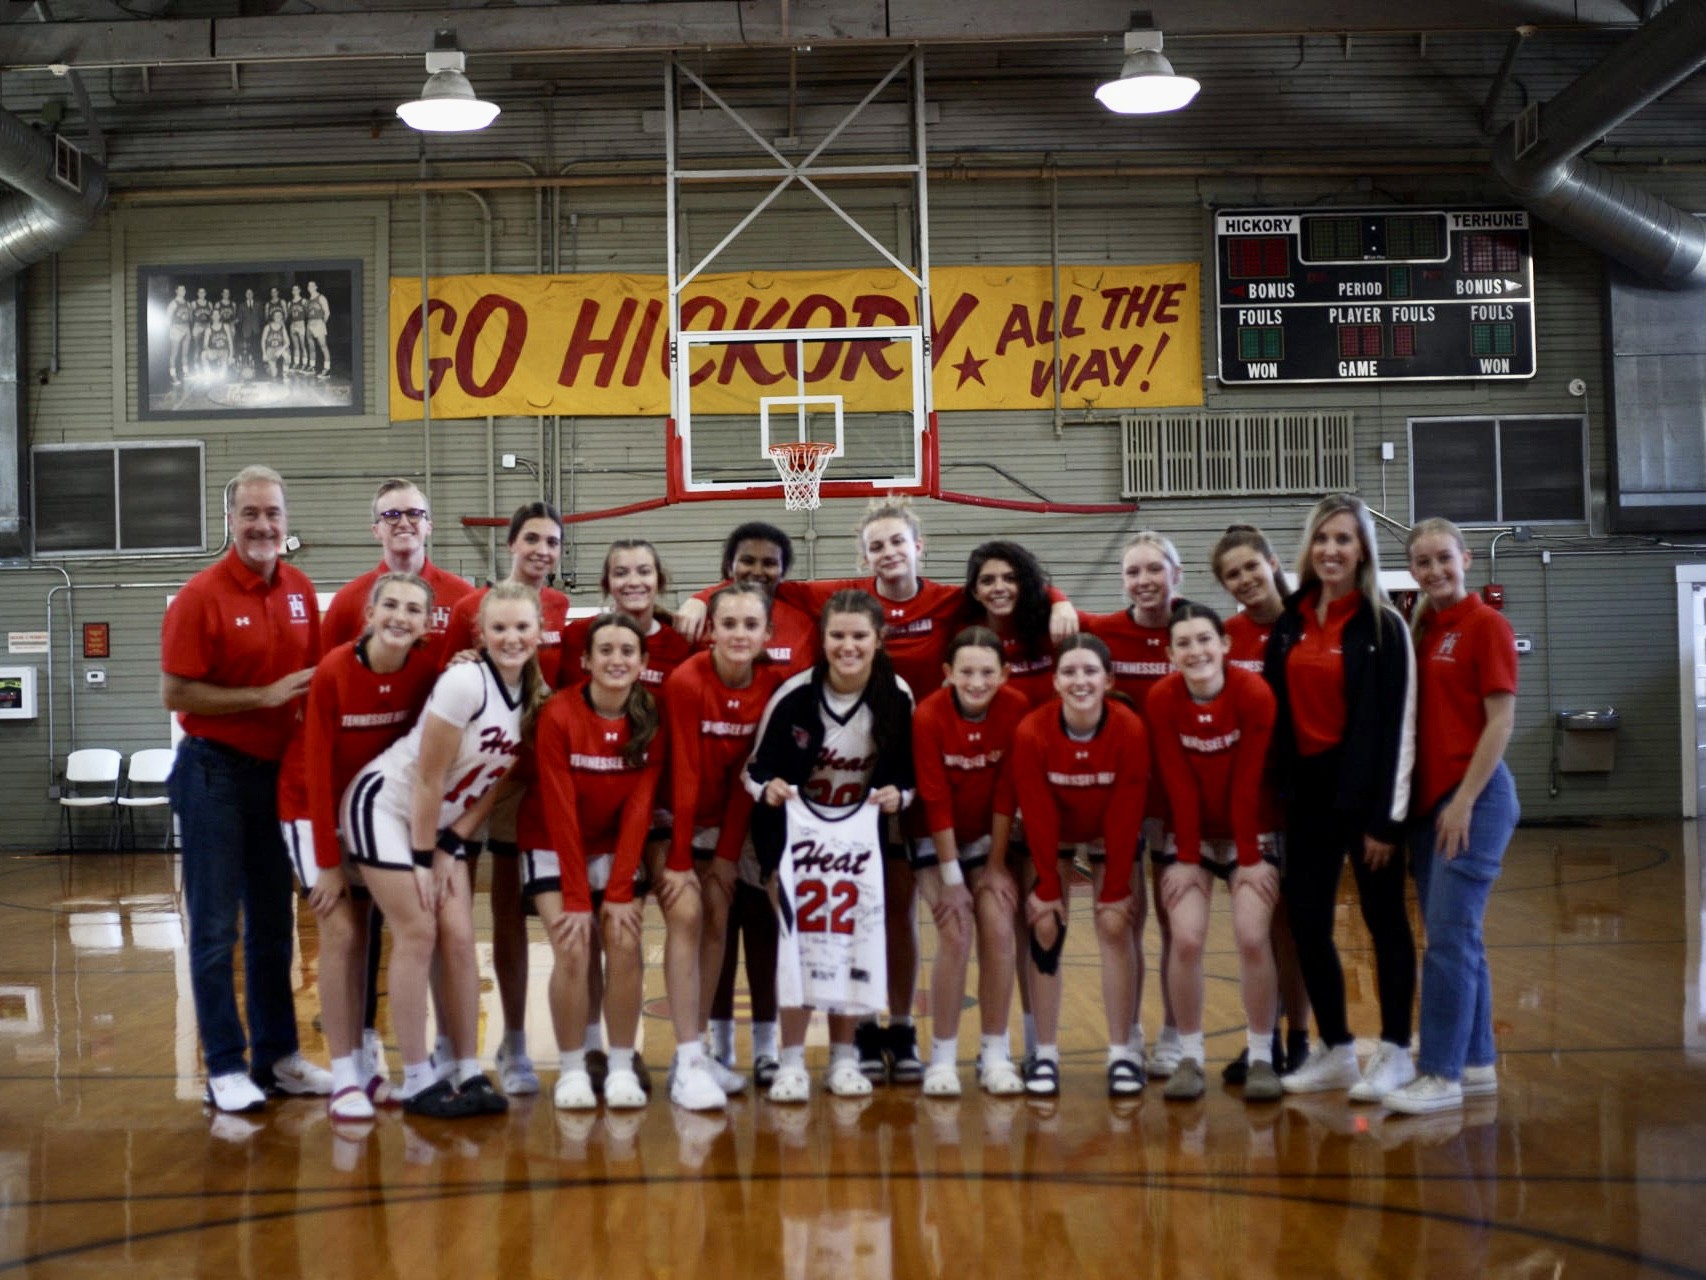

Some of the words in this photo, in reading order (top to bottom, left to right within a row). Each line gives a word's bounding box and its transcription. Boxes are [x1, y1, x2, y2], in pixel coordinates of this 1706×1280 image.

[1225, 218, 1293, 233] HICKORY
[1453, 213, 1524, 227] TERHUNE
[1248, 283, 1295, 299] BONUS
[1338, 282, 1382, 296] PERIOD
[1456, 279, 1502, 295] BONUS
[995, 294, 1086, 356] ALL
[1100, 282, 1187, 330] THE
[1238, 309, 1283, 325] FOULS
[1329, 307, 1381, 323] PLAYER
[1392, 306, 1436, 322] FOULS
[1471, 304, 1514, 321] FOULS
[396, 293, 528, 401] GO
[557, 291, 980, 388] HICKORY
[1030, 331, 1171, 398] WAY!
[1247, 362, 1278, 379] WON
[1338, 360, 1378, 377] GAME
[1480, 358, 1510, 374] WON
[791, 840, 872, 875] Heat
[795, 879, 860, 936] 22
